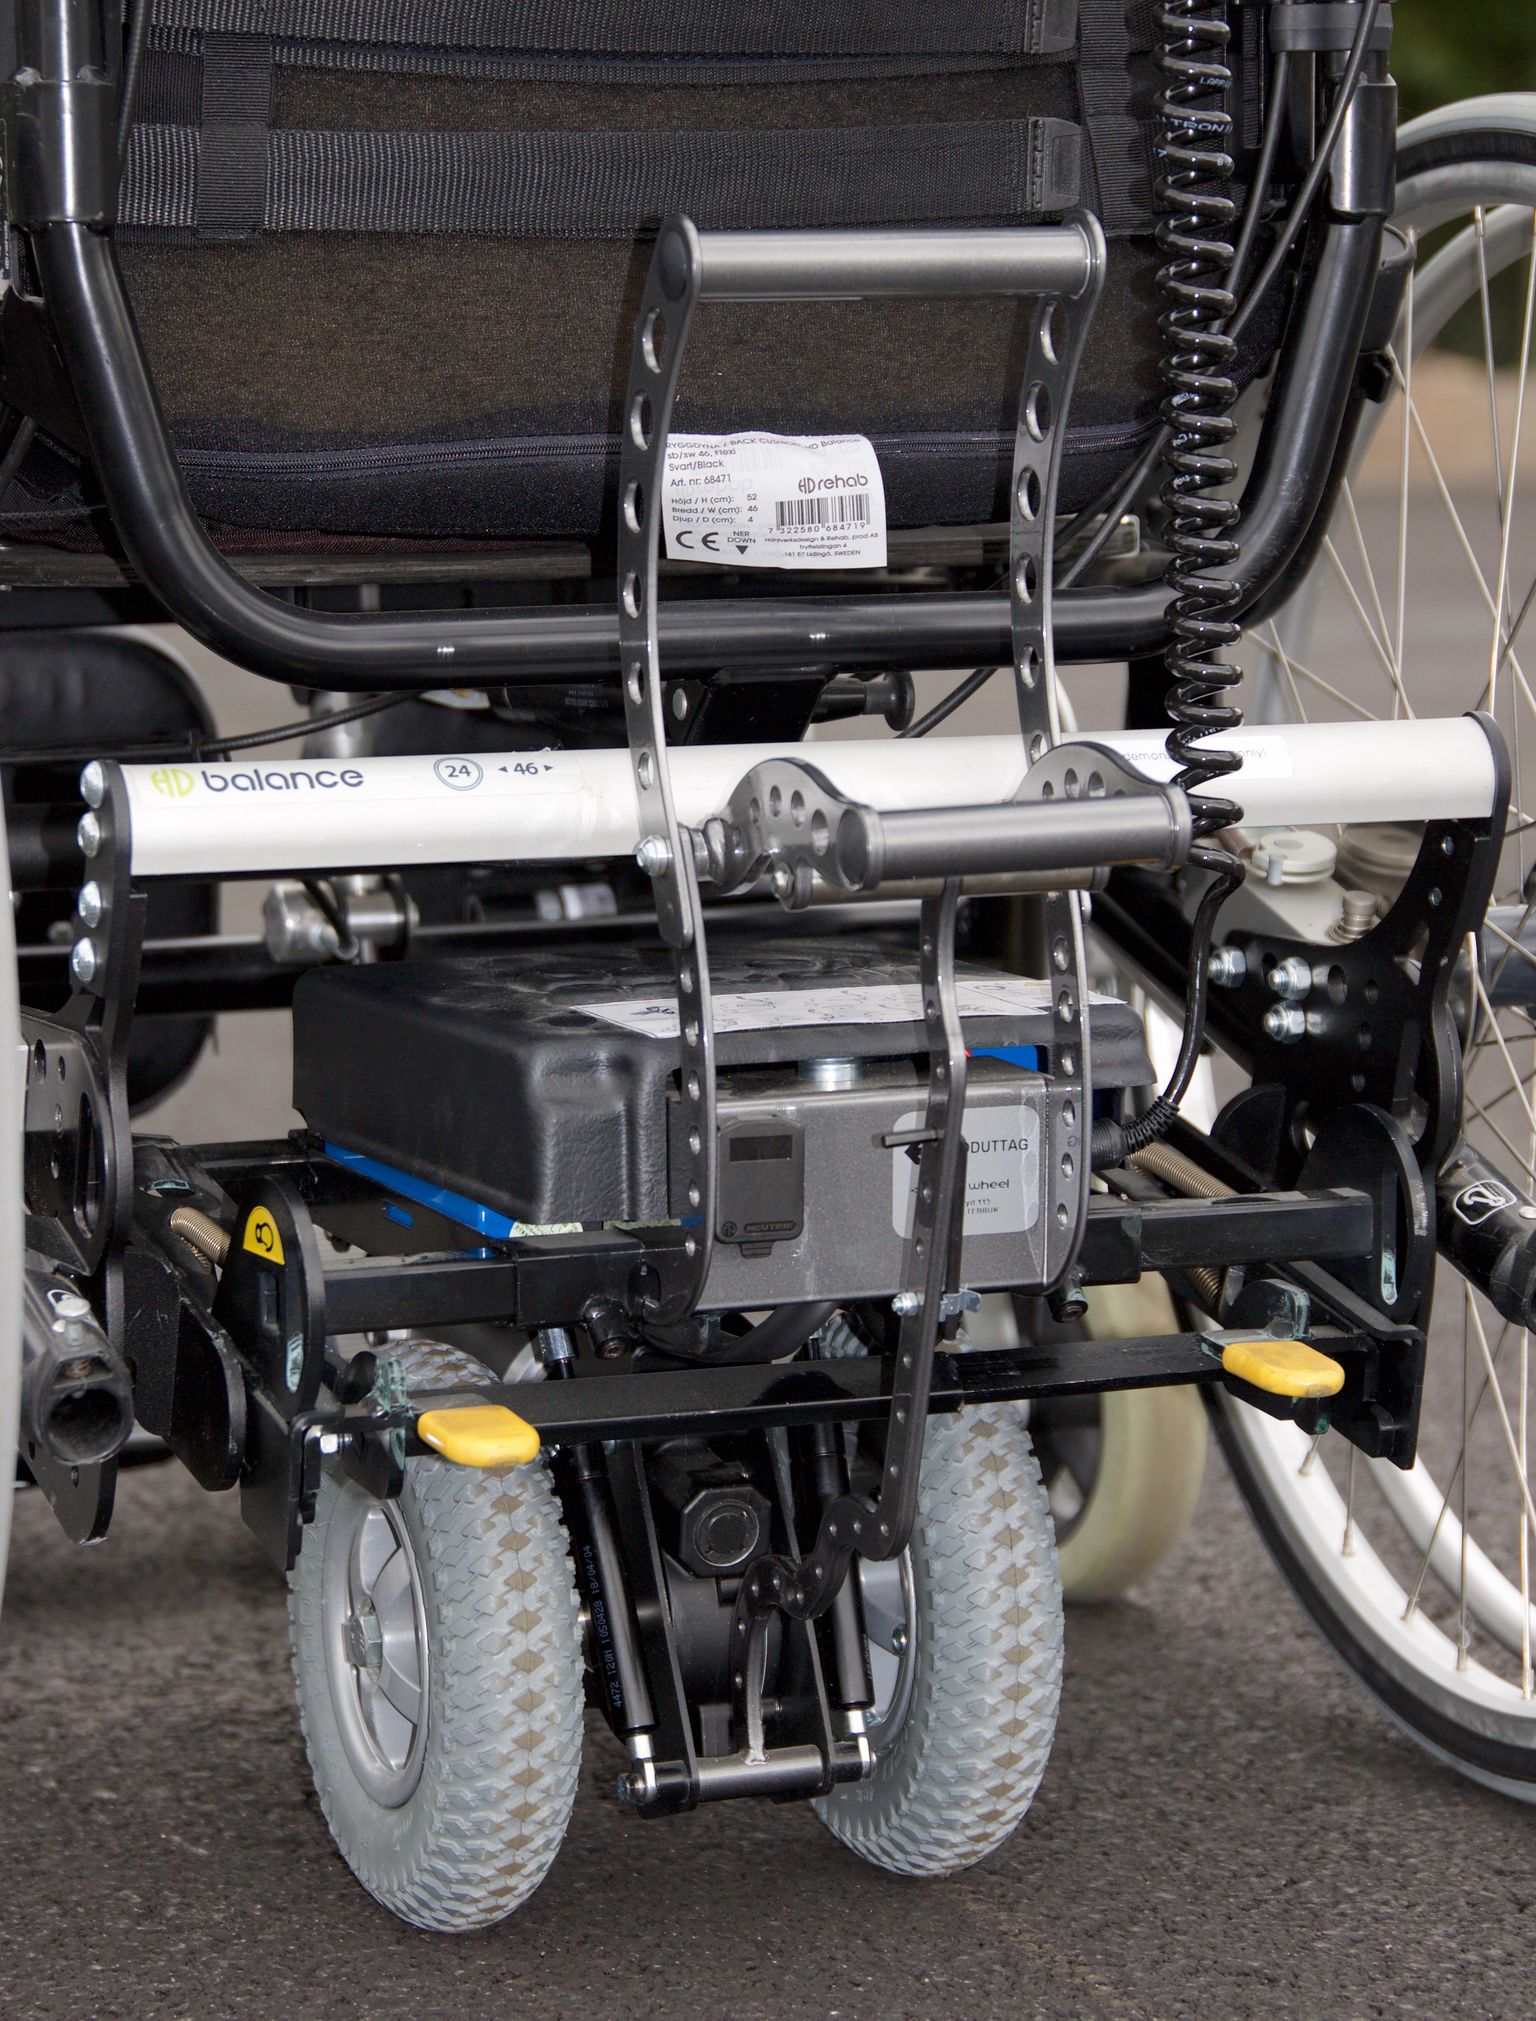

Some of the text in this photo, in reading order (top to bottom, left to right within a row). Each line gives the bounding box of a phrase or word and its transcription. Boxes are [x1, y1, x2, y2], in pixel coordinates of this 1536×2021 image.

[729, 438, 757, 446] BACK
[668, 460, 724, 472] Svart/Black
[670, 474, 731, 487] Art. nr: 68471
[817, 472, 868, 491] rehab
[671, 497, 692, 505] Höjd
[710, 495, 735, 505] (cm):
[747, 493, 758, 501] 52
[718, 506, 743, 515] (cm):
[672, 515, 694, 523] Djup
[712, 515, 736, 524] (cm):
[825, 521, 866, 532] 684719
[445, 765, 472, 778] 24
[513, 762, 539, 775] 46
[201, 768, 364, 793] balance
[583, 1544, 600, 1595] 18/04/04
[610, 1680, 622, 1708] 4472
